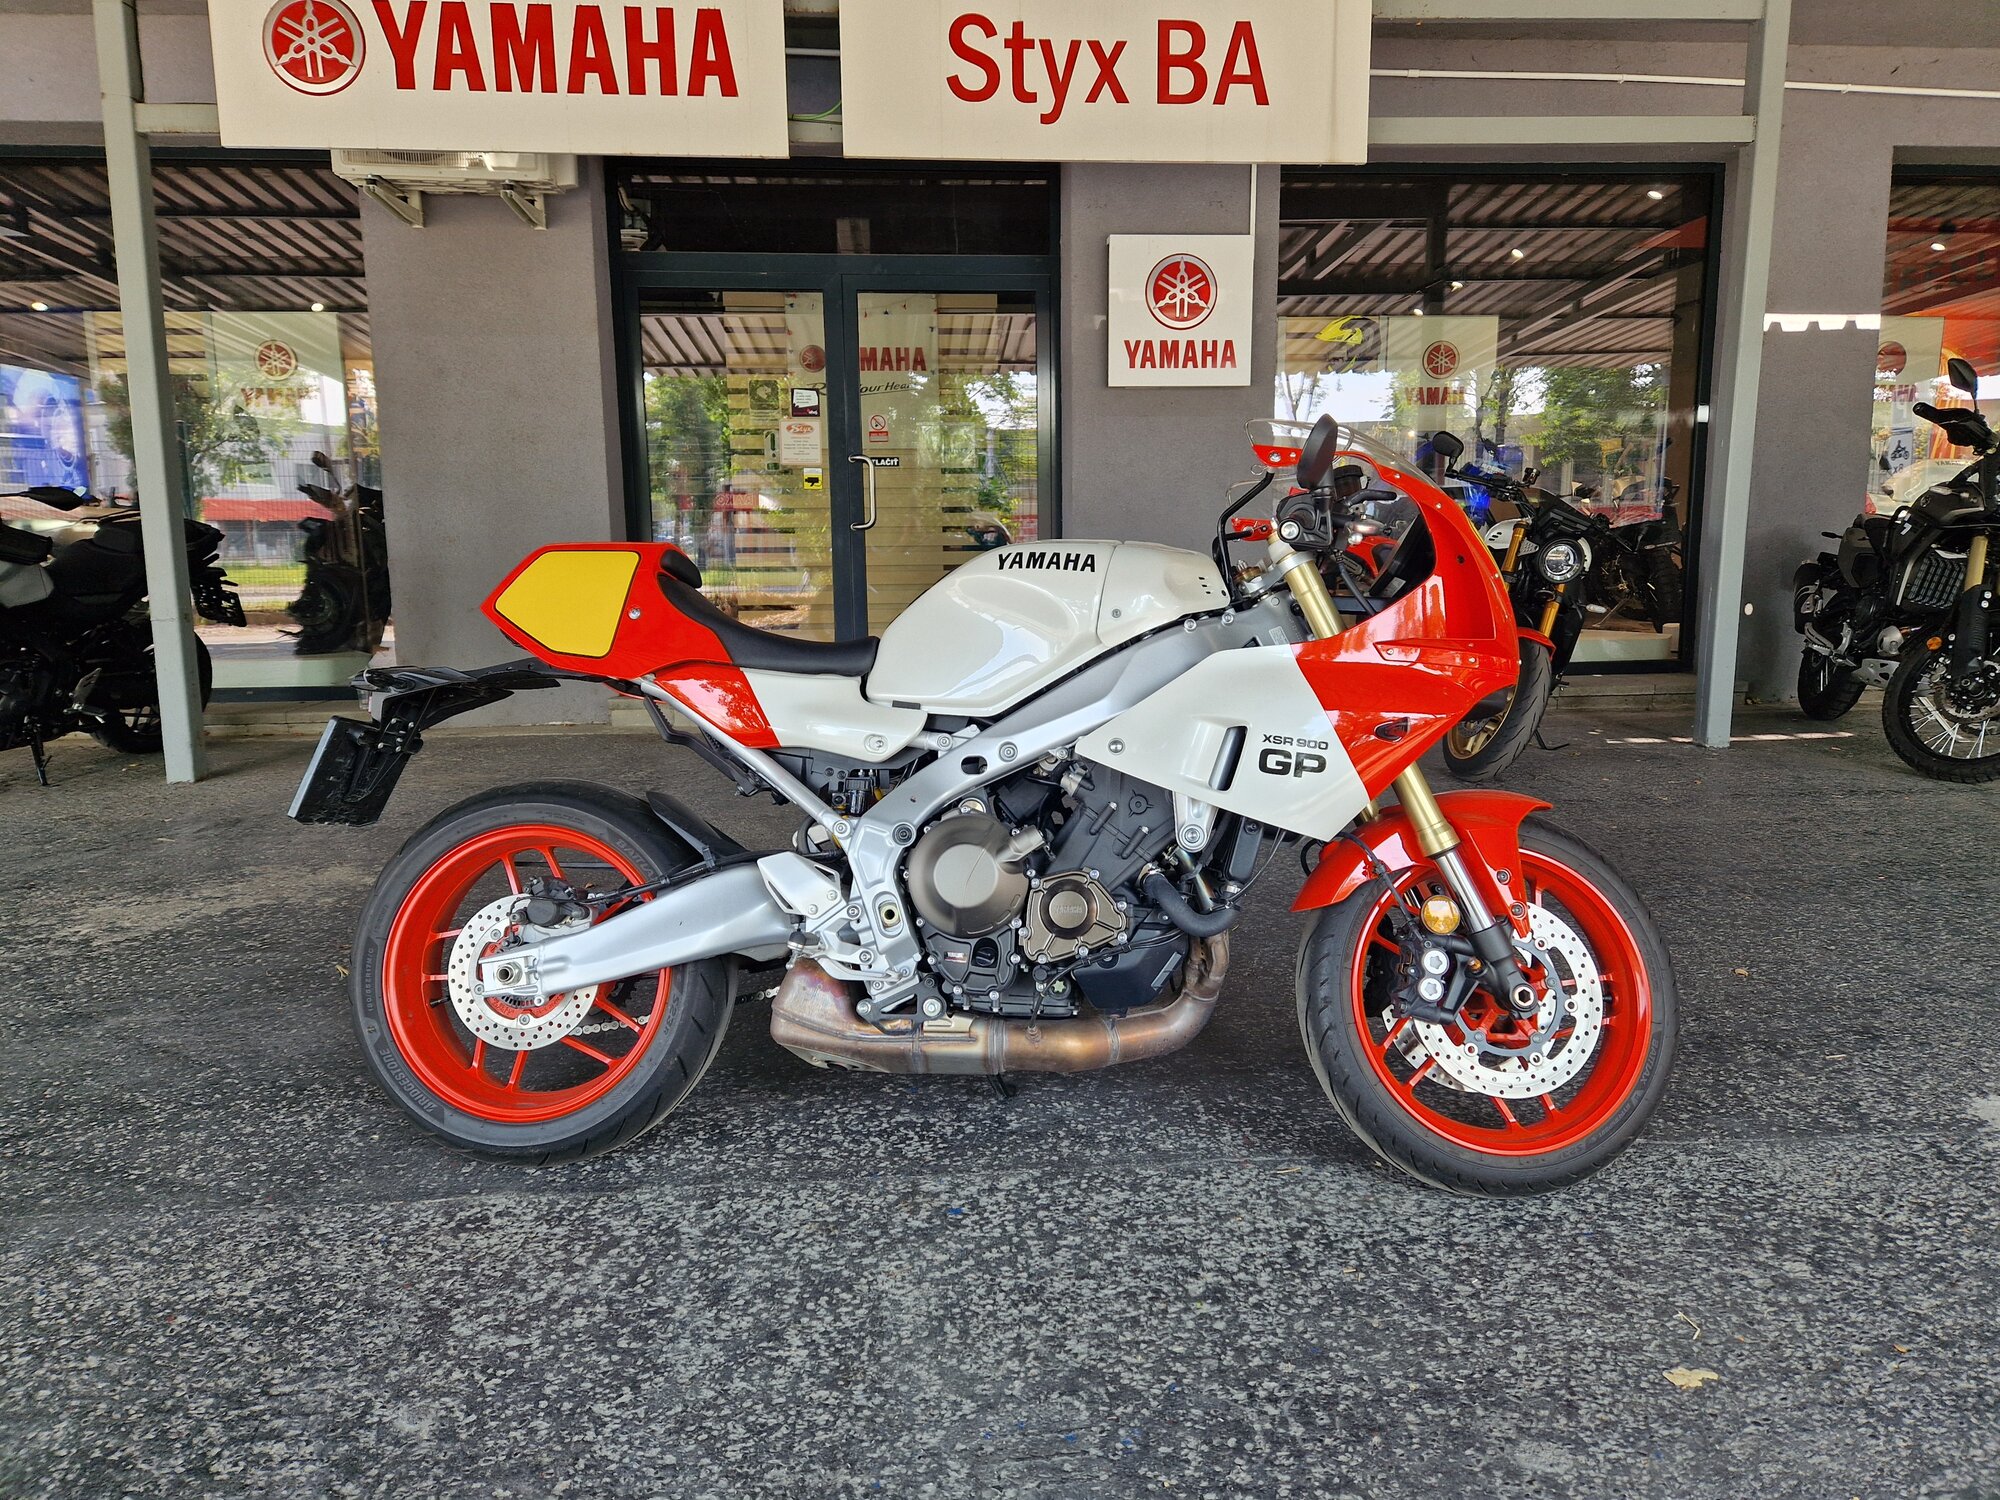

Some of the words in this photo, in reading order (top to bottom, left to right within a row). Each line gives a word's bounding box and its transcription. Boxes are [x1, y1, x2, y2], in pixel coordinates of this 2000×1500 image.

[371, 0, 739, 97] YAMAHA
[946, 13, 1130, 125] Styx
[1156, 19, 1270, 106] BA
[859, 346, 927, 372] MAHA
[1123, 339, 1237, 369] YAMAHA
[998, 551, 1096, 573] YAMAHA
[1262, 733, 1294, 747] XSR
[1296, 737, 1329, 751] 900
[1258, 747, 1327, 779] GP
[378, 1048, 438, 1115] BRIDGESTONE
